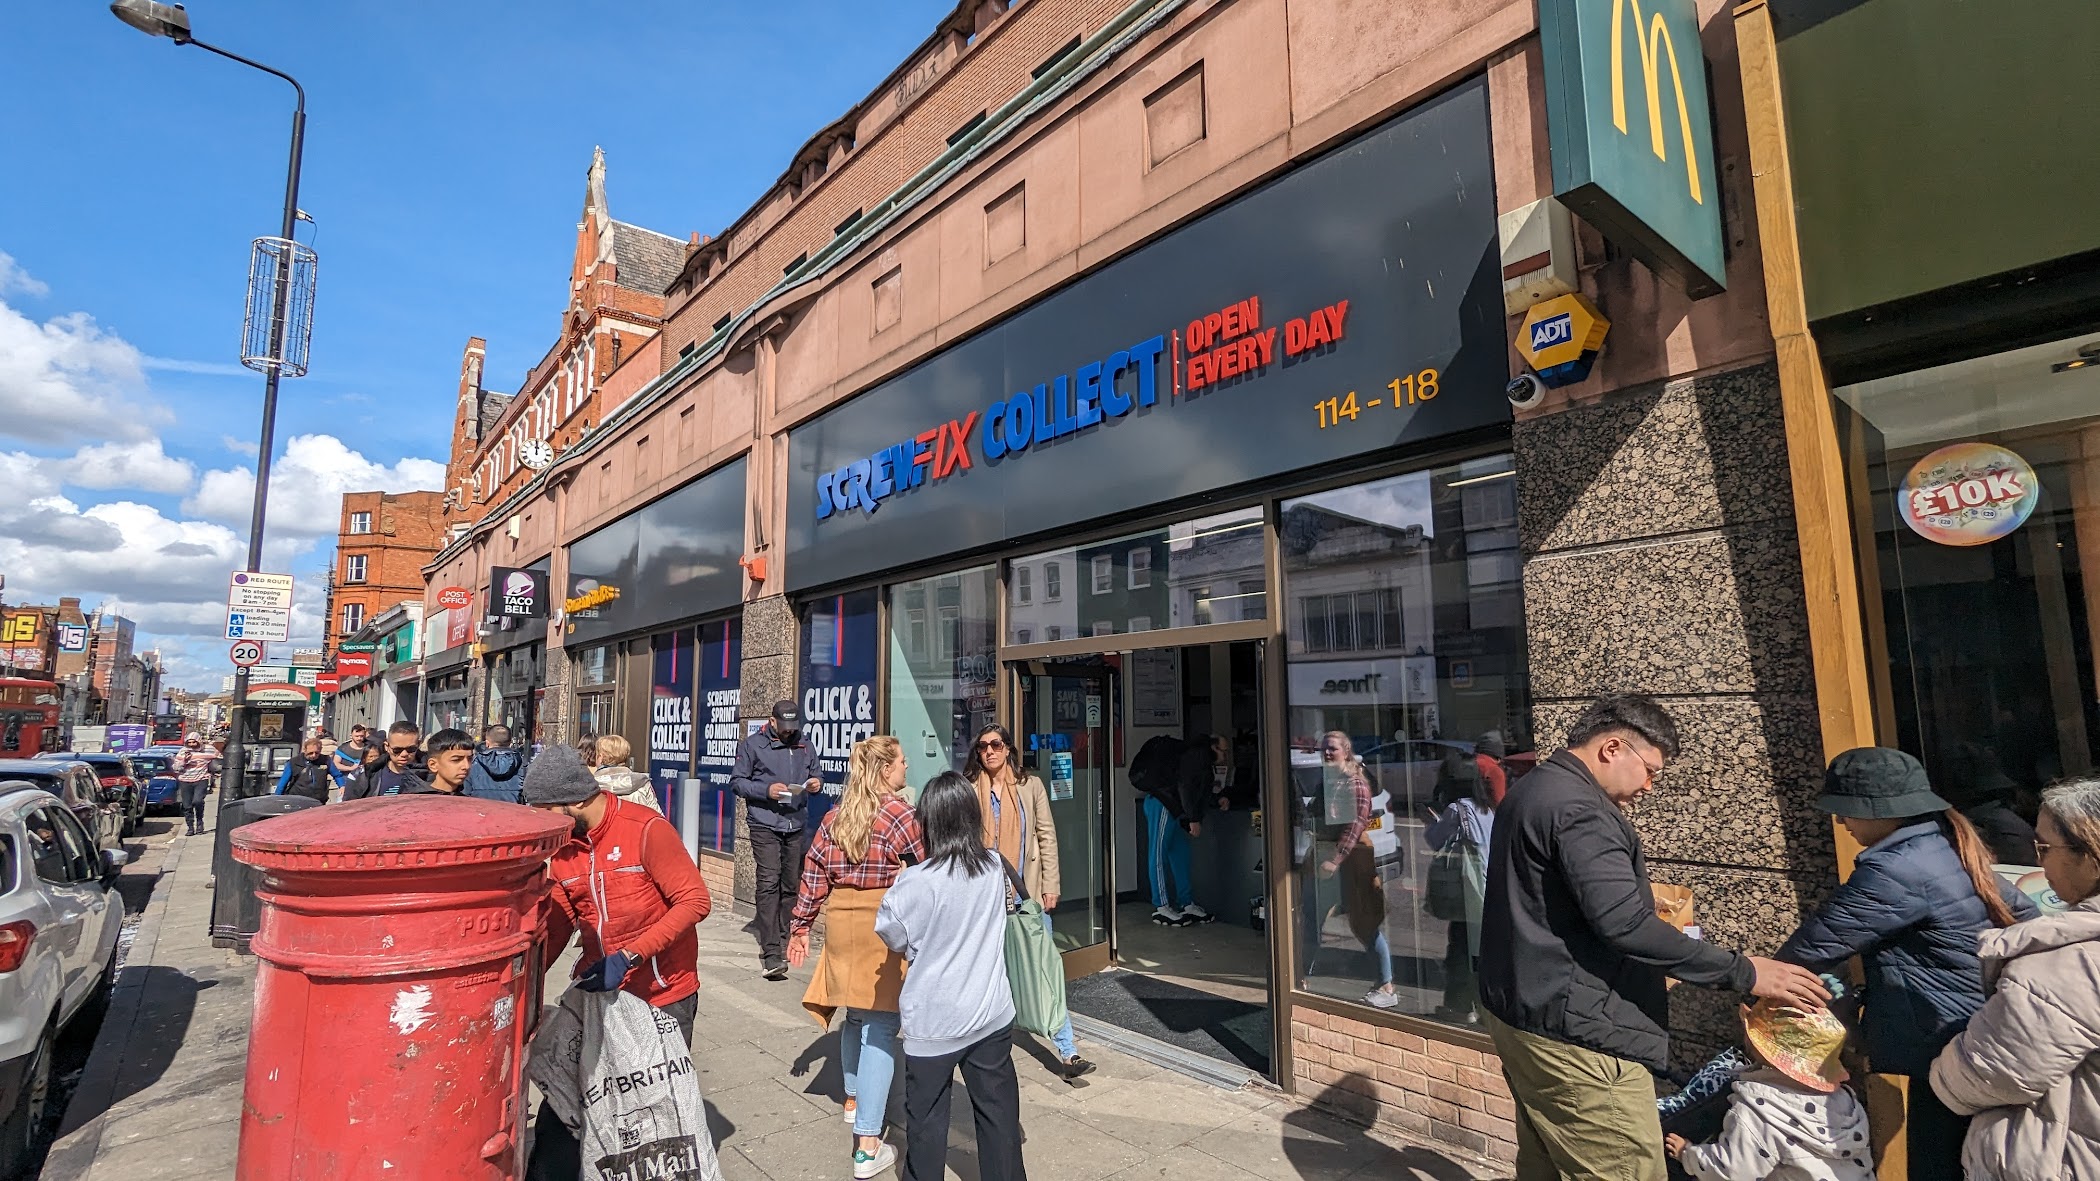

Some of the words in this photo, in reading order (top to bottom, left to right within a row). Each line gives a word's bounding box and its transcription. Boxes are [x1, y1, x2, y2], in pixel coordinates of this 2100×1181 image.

[1186, 296, 1260, 355] OPEN
[1532, 316, 1571, 348] ADT
[1187, 327, 1277, 393] EVERY
[1285, 300, 1350, 356] DAY
[1314, 391, 1358, 430] 114
[1388, 367, 1440, 410] 118
[816, 410, 977, 521] SCREWFIX
[982, 335, 1165, 460] COLLECT
[1913, 472, 2023, 517] £10K
[440, 597, 468, 605] OFFICE
[503, 595, 534, 606] TACO
[504, 605, 533, 615] BELL
[235, 648, 258, 659] 20
[707, 689, 741, 707] SCREWFIX
[804, 686, 853, 721] CLICK
[855, 684, 873, 720] &
[1057, 690, 1078, 702] SAVE
[654, 697, 682, 724] CLICK
[681, 696, 691, 723] &
[711, 706, 736, 723] SPRINT
[651, 724, 692, 751] COLLECT
[705, 723, 714, 740] 60
[707, 740, 738, 757] DELIVERY
[834, 760, 843, 773] AS
[460, 907, 512, 937] POST
[657, 1020, 679, 1035] SGP
[615, 1056, 696, 1094] BRITAIN
[644, 1146, 699, 1181] Mail
